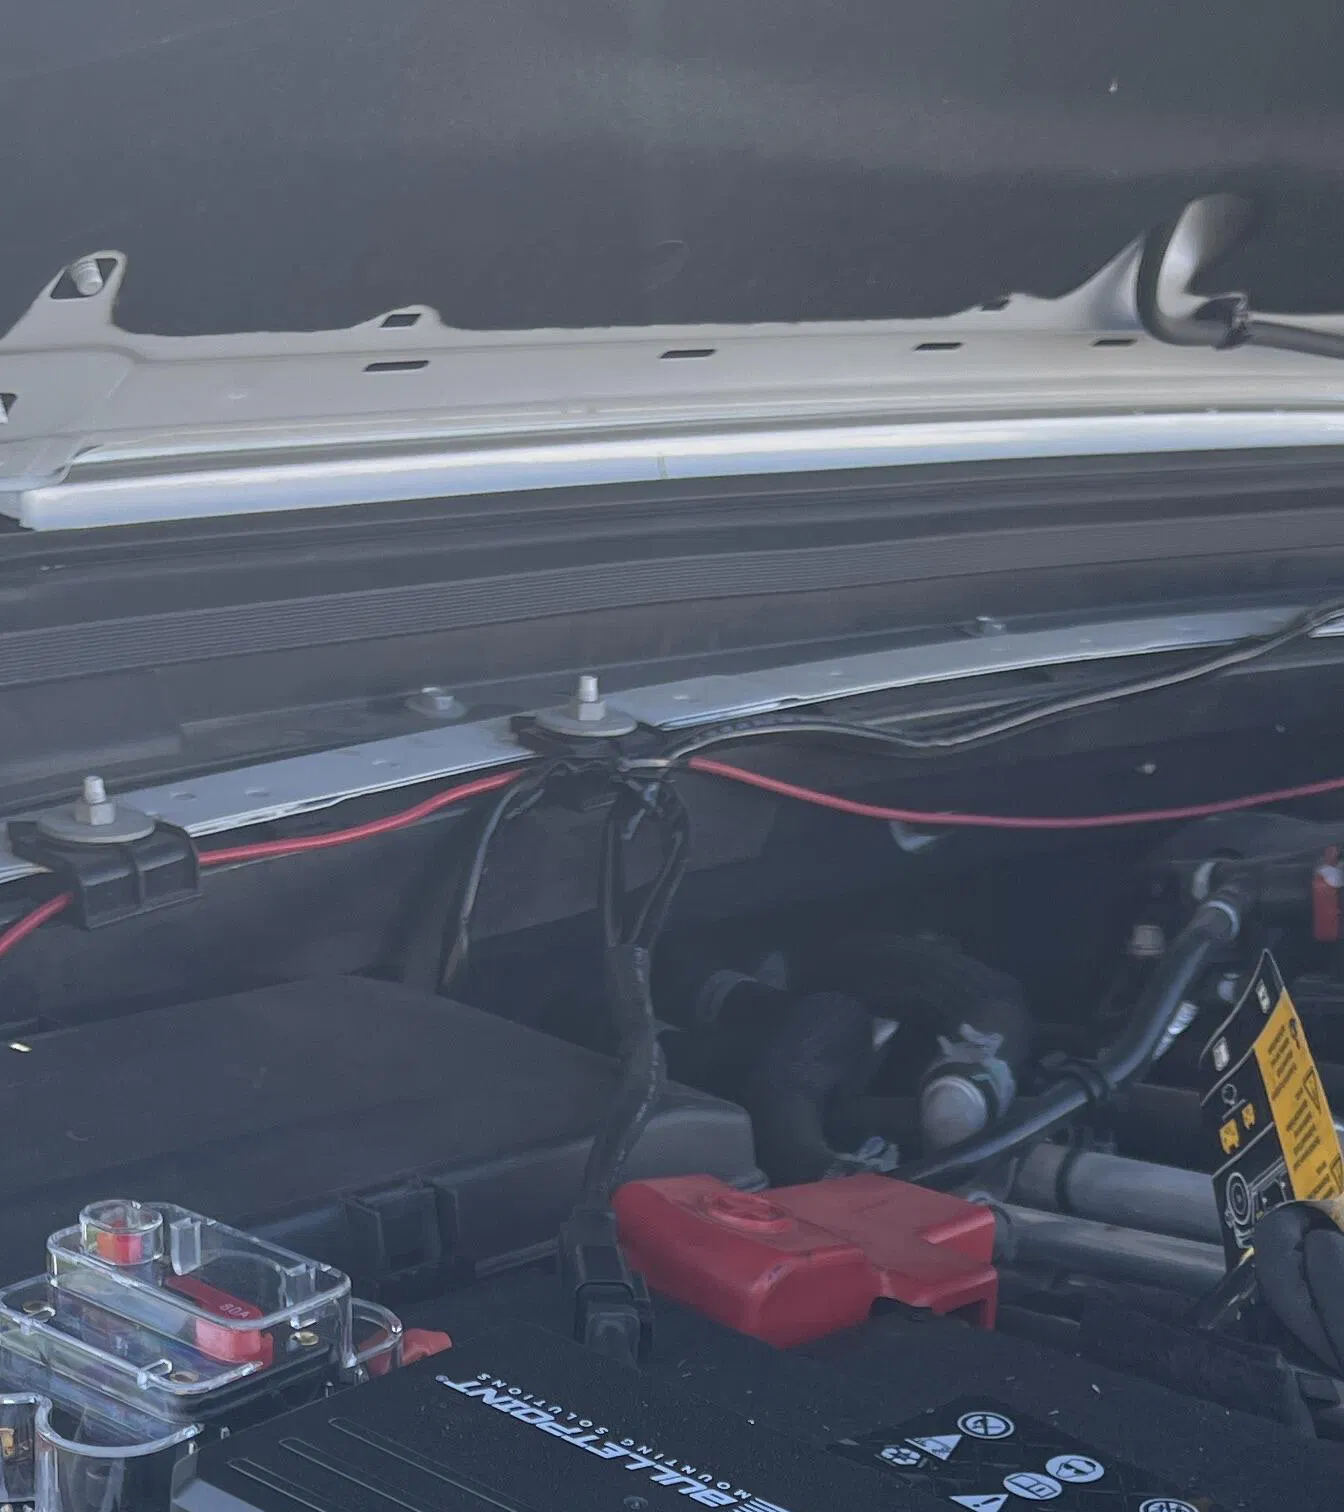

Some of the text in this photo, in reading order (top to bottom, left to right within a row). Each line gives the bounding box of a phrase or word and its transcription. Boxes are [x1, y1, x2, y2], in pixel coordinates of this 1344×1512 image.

[218, 1303, 251, 1319] 80A
[442, 1380, 739, 1508] BULLETPOINT
[476, 1373, 752, 1500] MOUNTING SOLUTIONS
